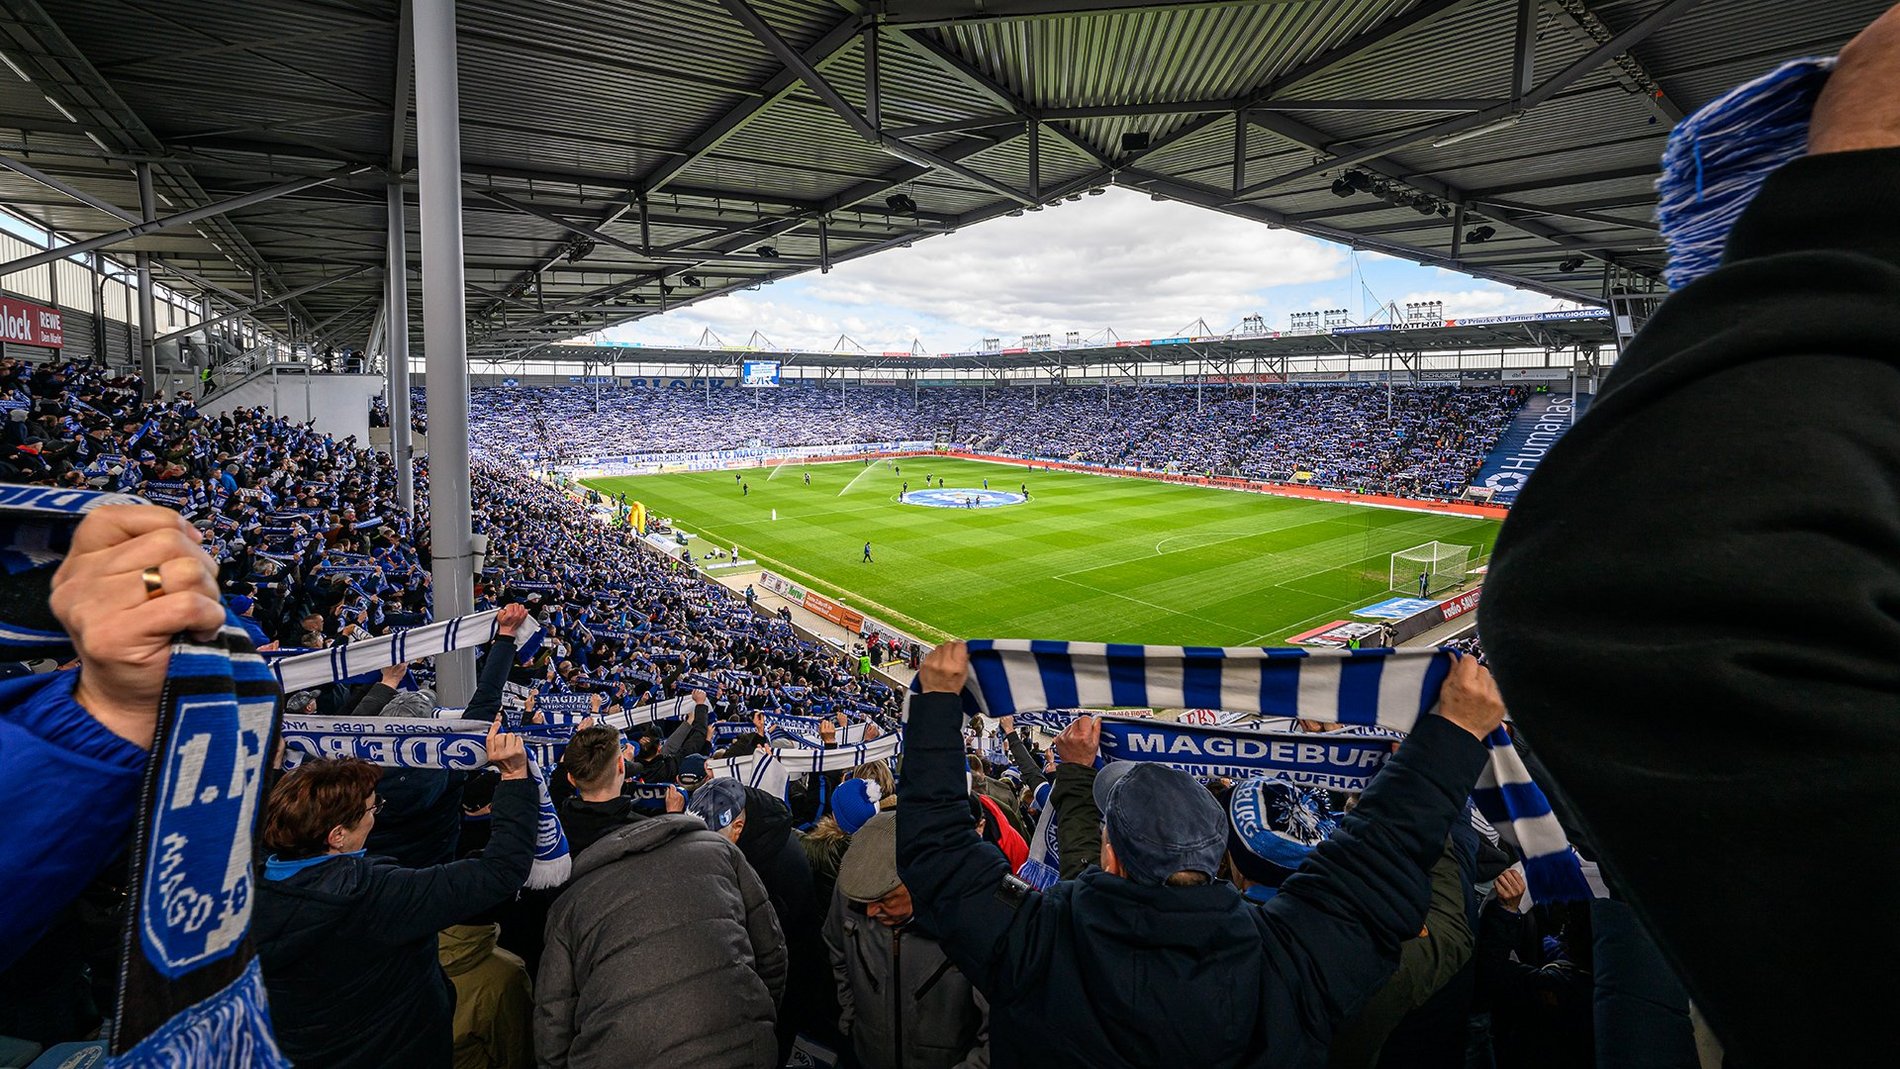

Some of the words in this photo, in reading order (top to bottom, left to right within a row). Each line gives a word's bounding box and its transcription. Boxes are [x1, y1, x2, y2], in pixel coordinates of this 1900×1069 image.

[40, 311, 61, 330] REWE
[1501, 397, 1574, 470] Humanas
[1443, 601, 1461, 619] radio
[332, 723, 376, 733] LIEBE
[1213, 766, 1264, 780] UNS
